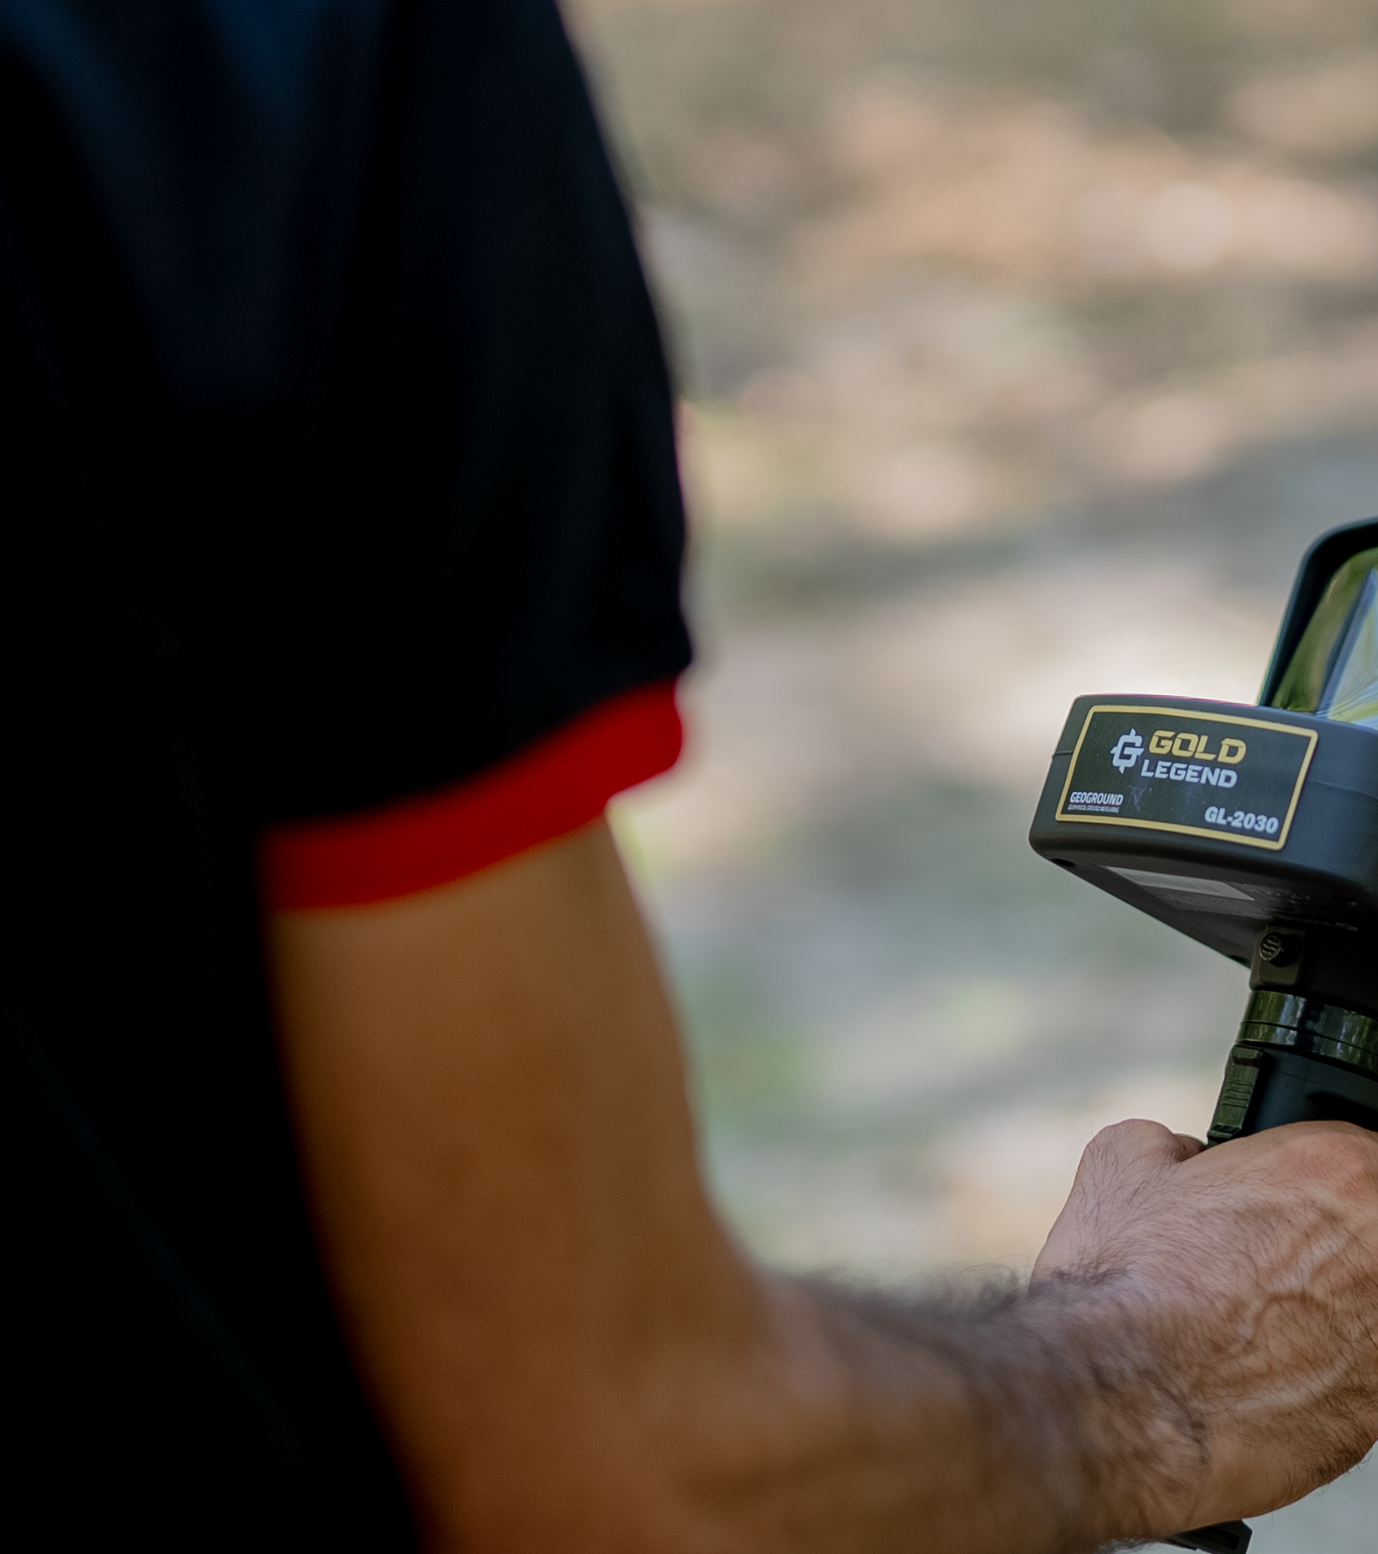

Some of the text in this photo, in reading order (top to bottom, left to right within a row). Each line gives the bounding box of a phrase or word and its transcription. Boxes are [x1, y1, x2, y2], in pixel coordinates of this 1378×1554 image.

[1149, 730, 1246, 763] GOLD
[1141, 760, 1238, 788] LEGEND
[1069, 791, 1124, 806] GEOGROUND
[1205, 805, 1279, 834] GL-2030
